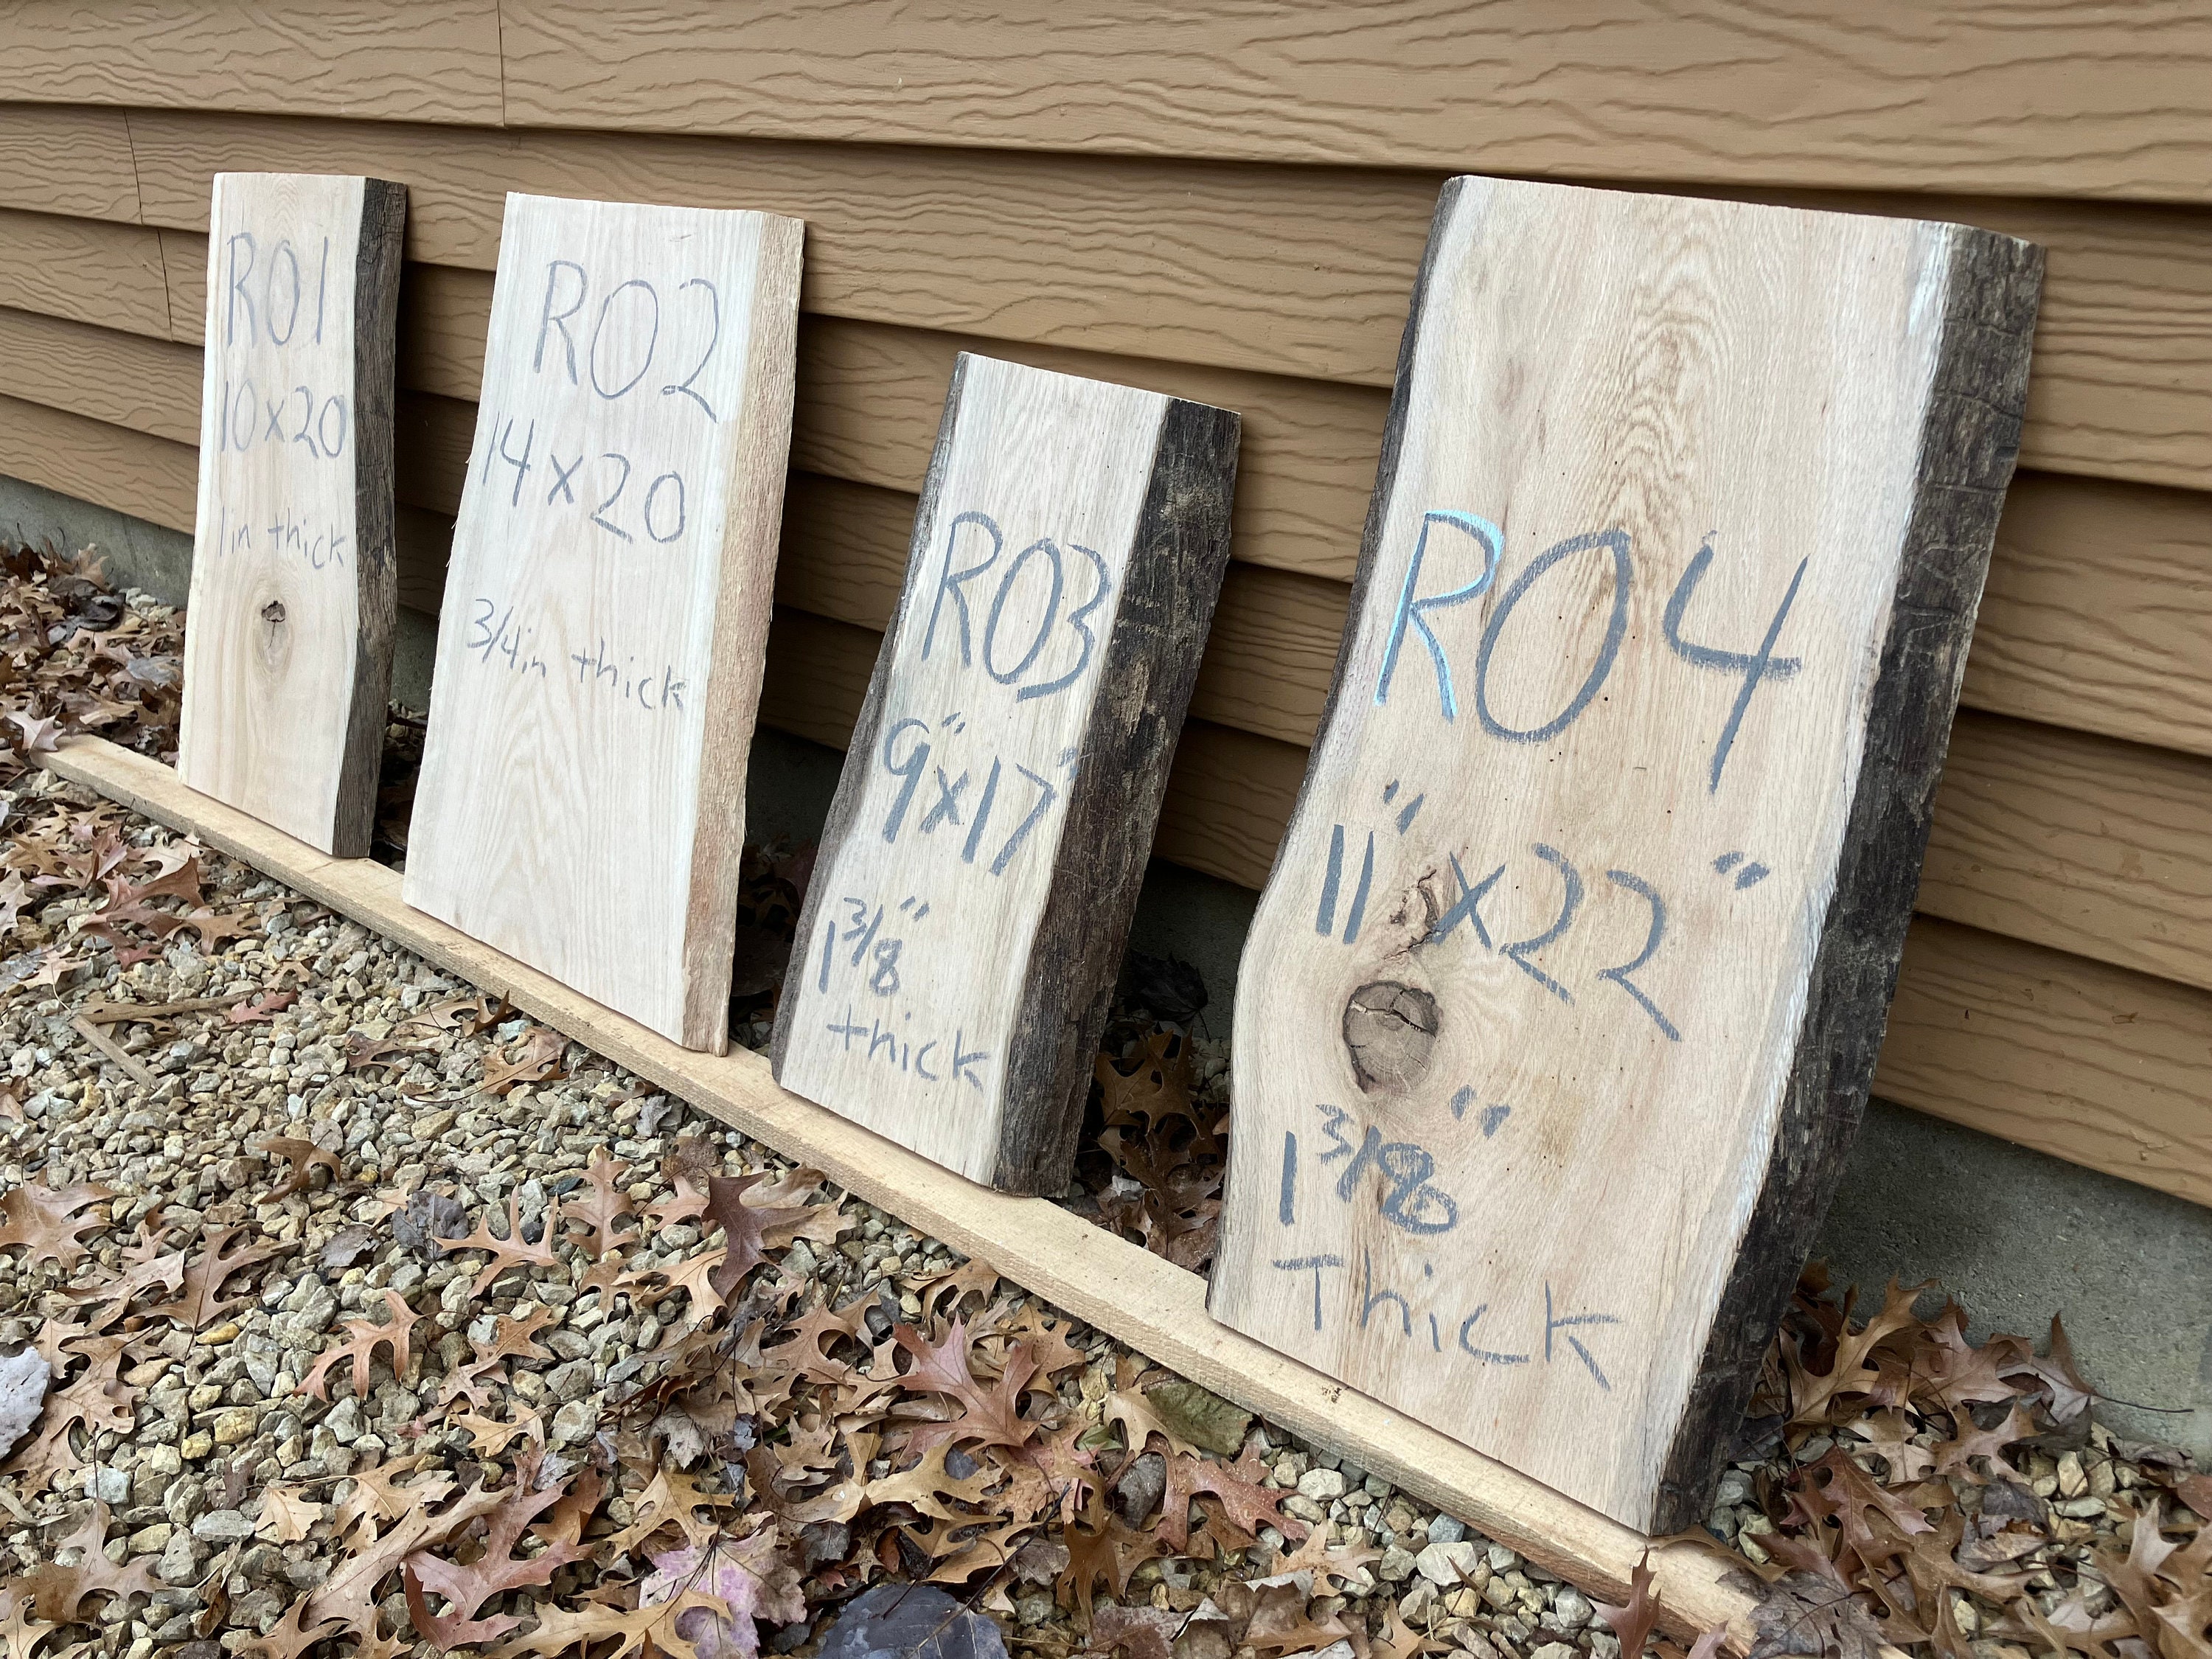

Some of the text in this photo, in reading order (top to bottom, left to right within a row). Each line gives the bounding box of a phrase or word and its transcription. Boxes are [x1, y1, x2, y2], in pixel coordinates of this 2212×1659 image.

[220, 378, 349, 460] 10x20
[481, 411, 686, 544] 14x20
[267, 507, 347, 569] thick
[571, 636, 687, 712] thick
[827, 1010, 990, 1091] thick
[1272, 1246, 1622, 1391] Thick
